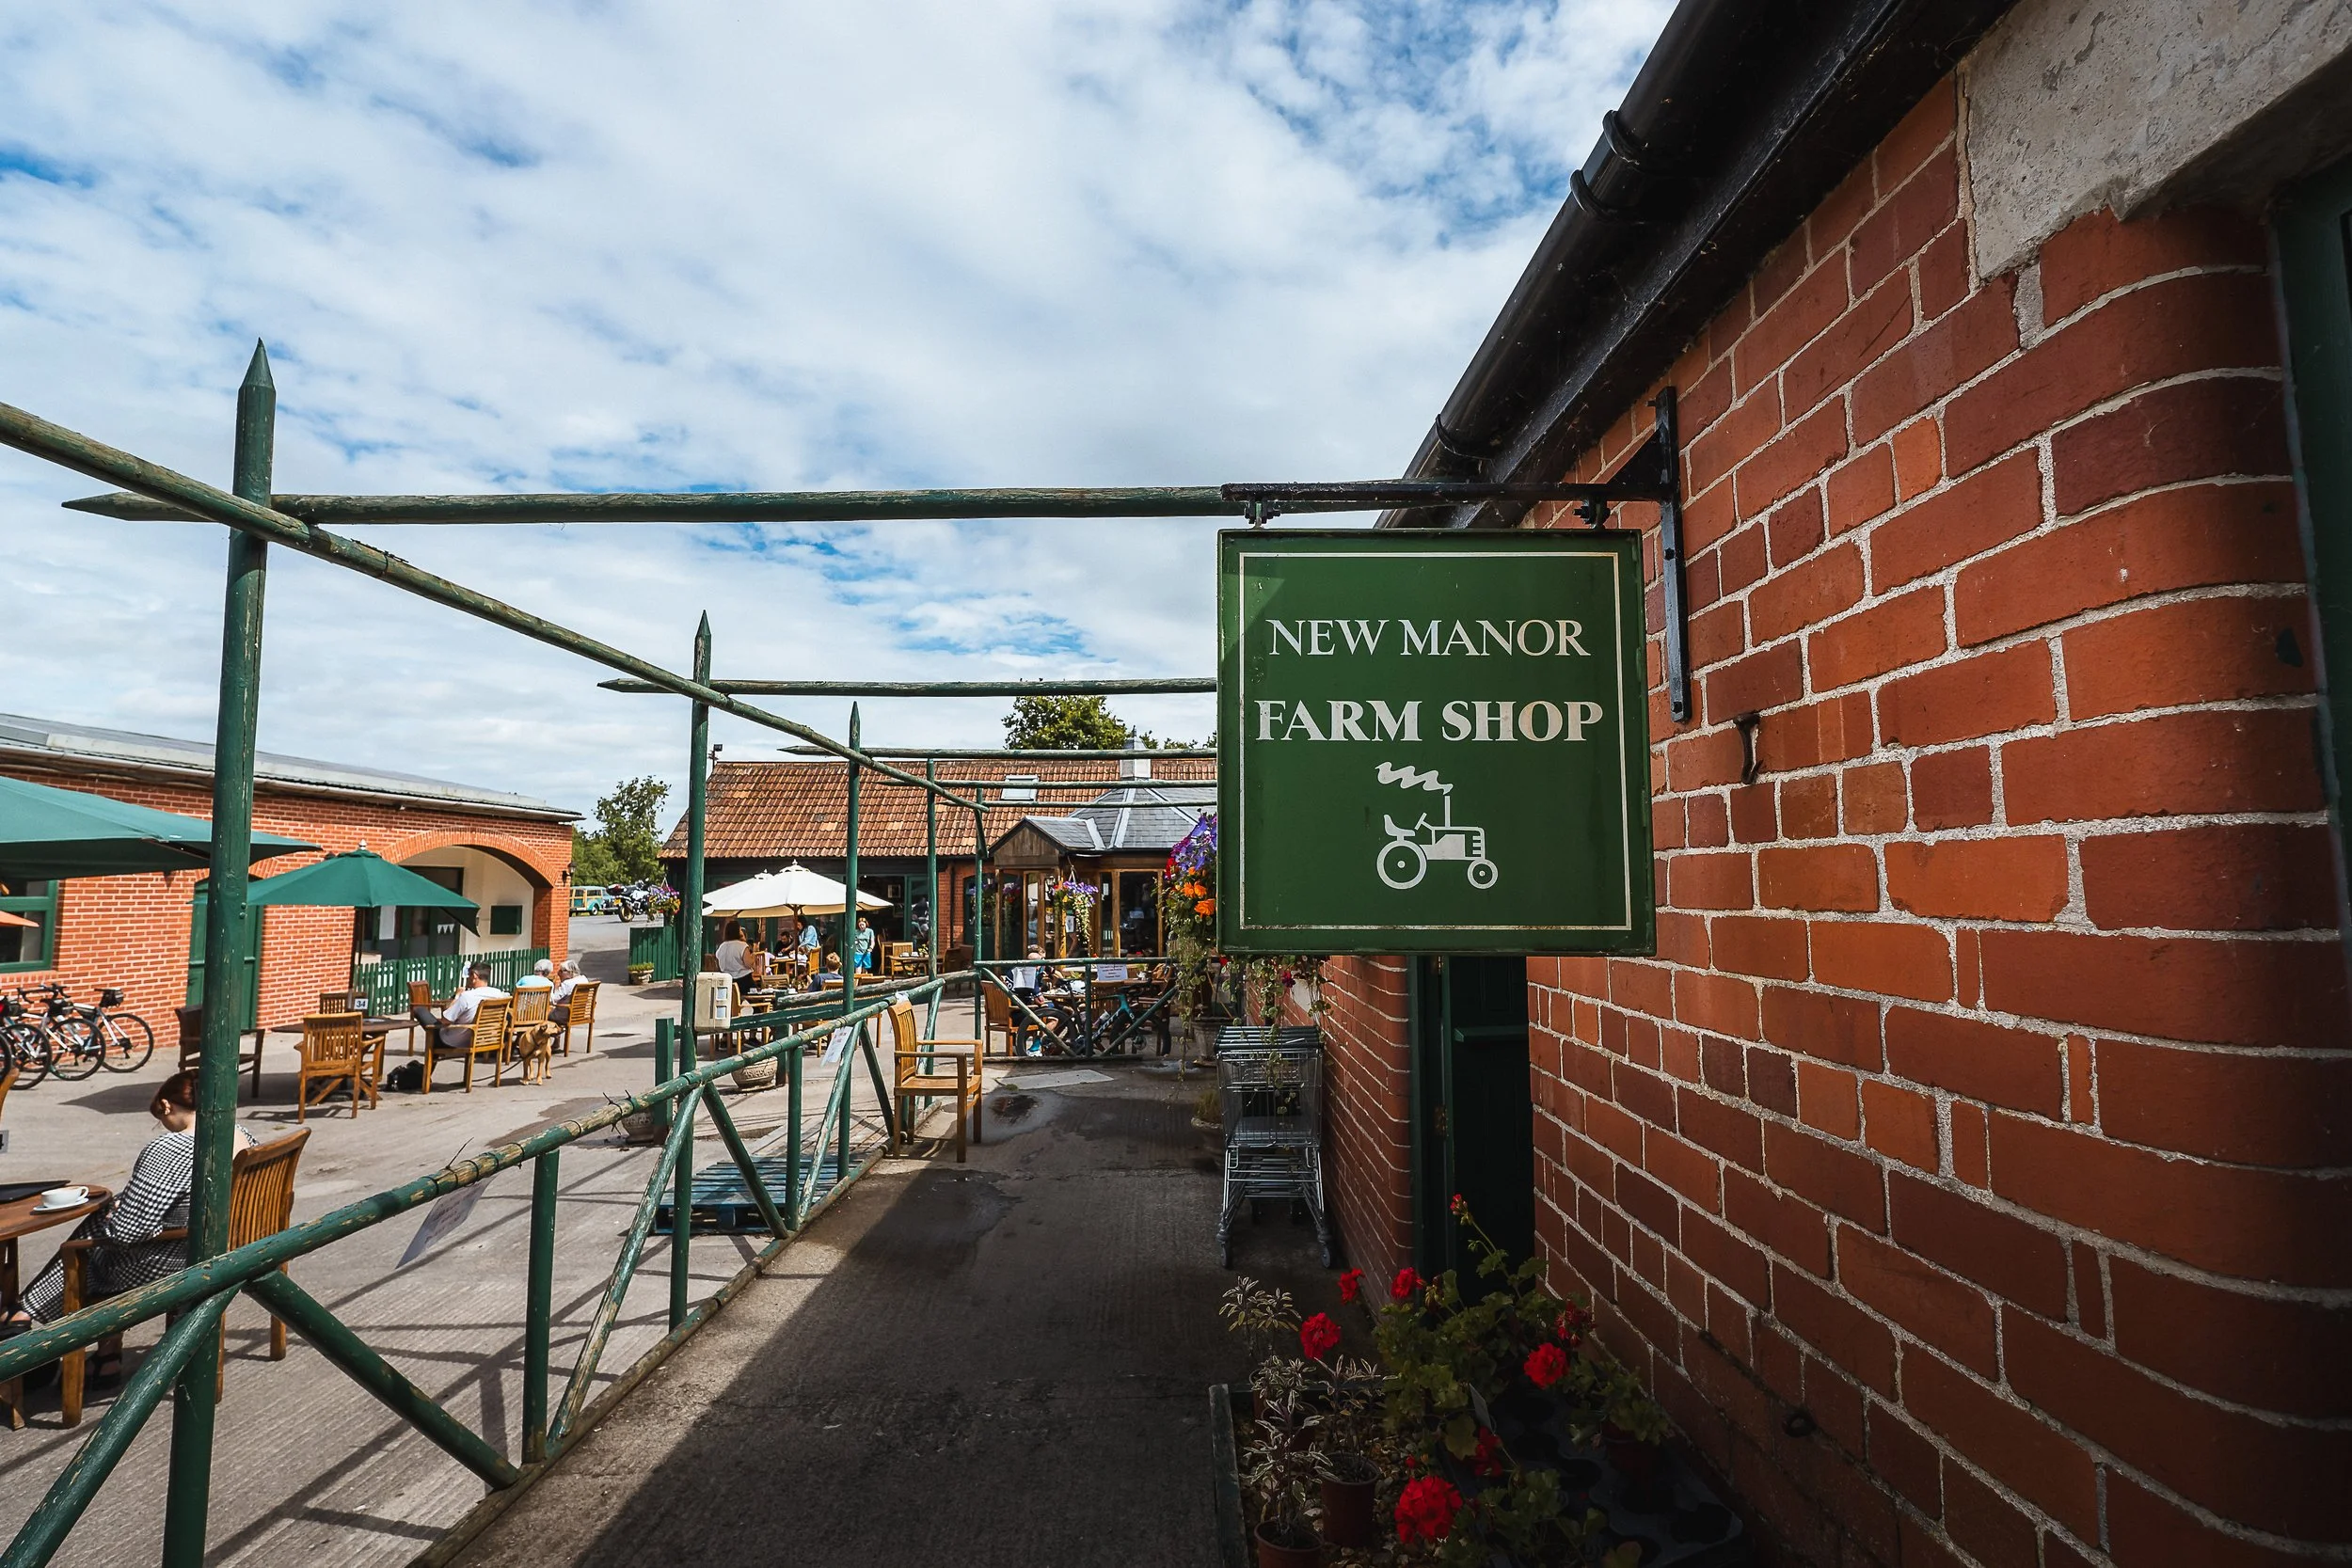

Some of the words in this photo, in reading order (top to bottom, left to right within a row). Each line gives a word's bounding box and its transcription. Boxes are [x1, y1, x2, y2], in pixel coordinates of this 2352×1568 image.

[1265, 619, 1390, 657] NEW
[1397, 619, 1592, 657] MANOR
[1254, 700, 1423, 742] FARM
[1441, 700, 1603, 742] SHOP
[356, 1000, 367, 1008] 34
